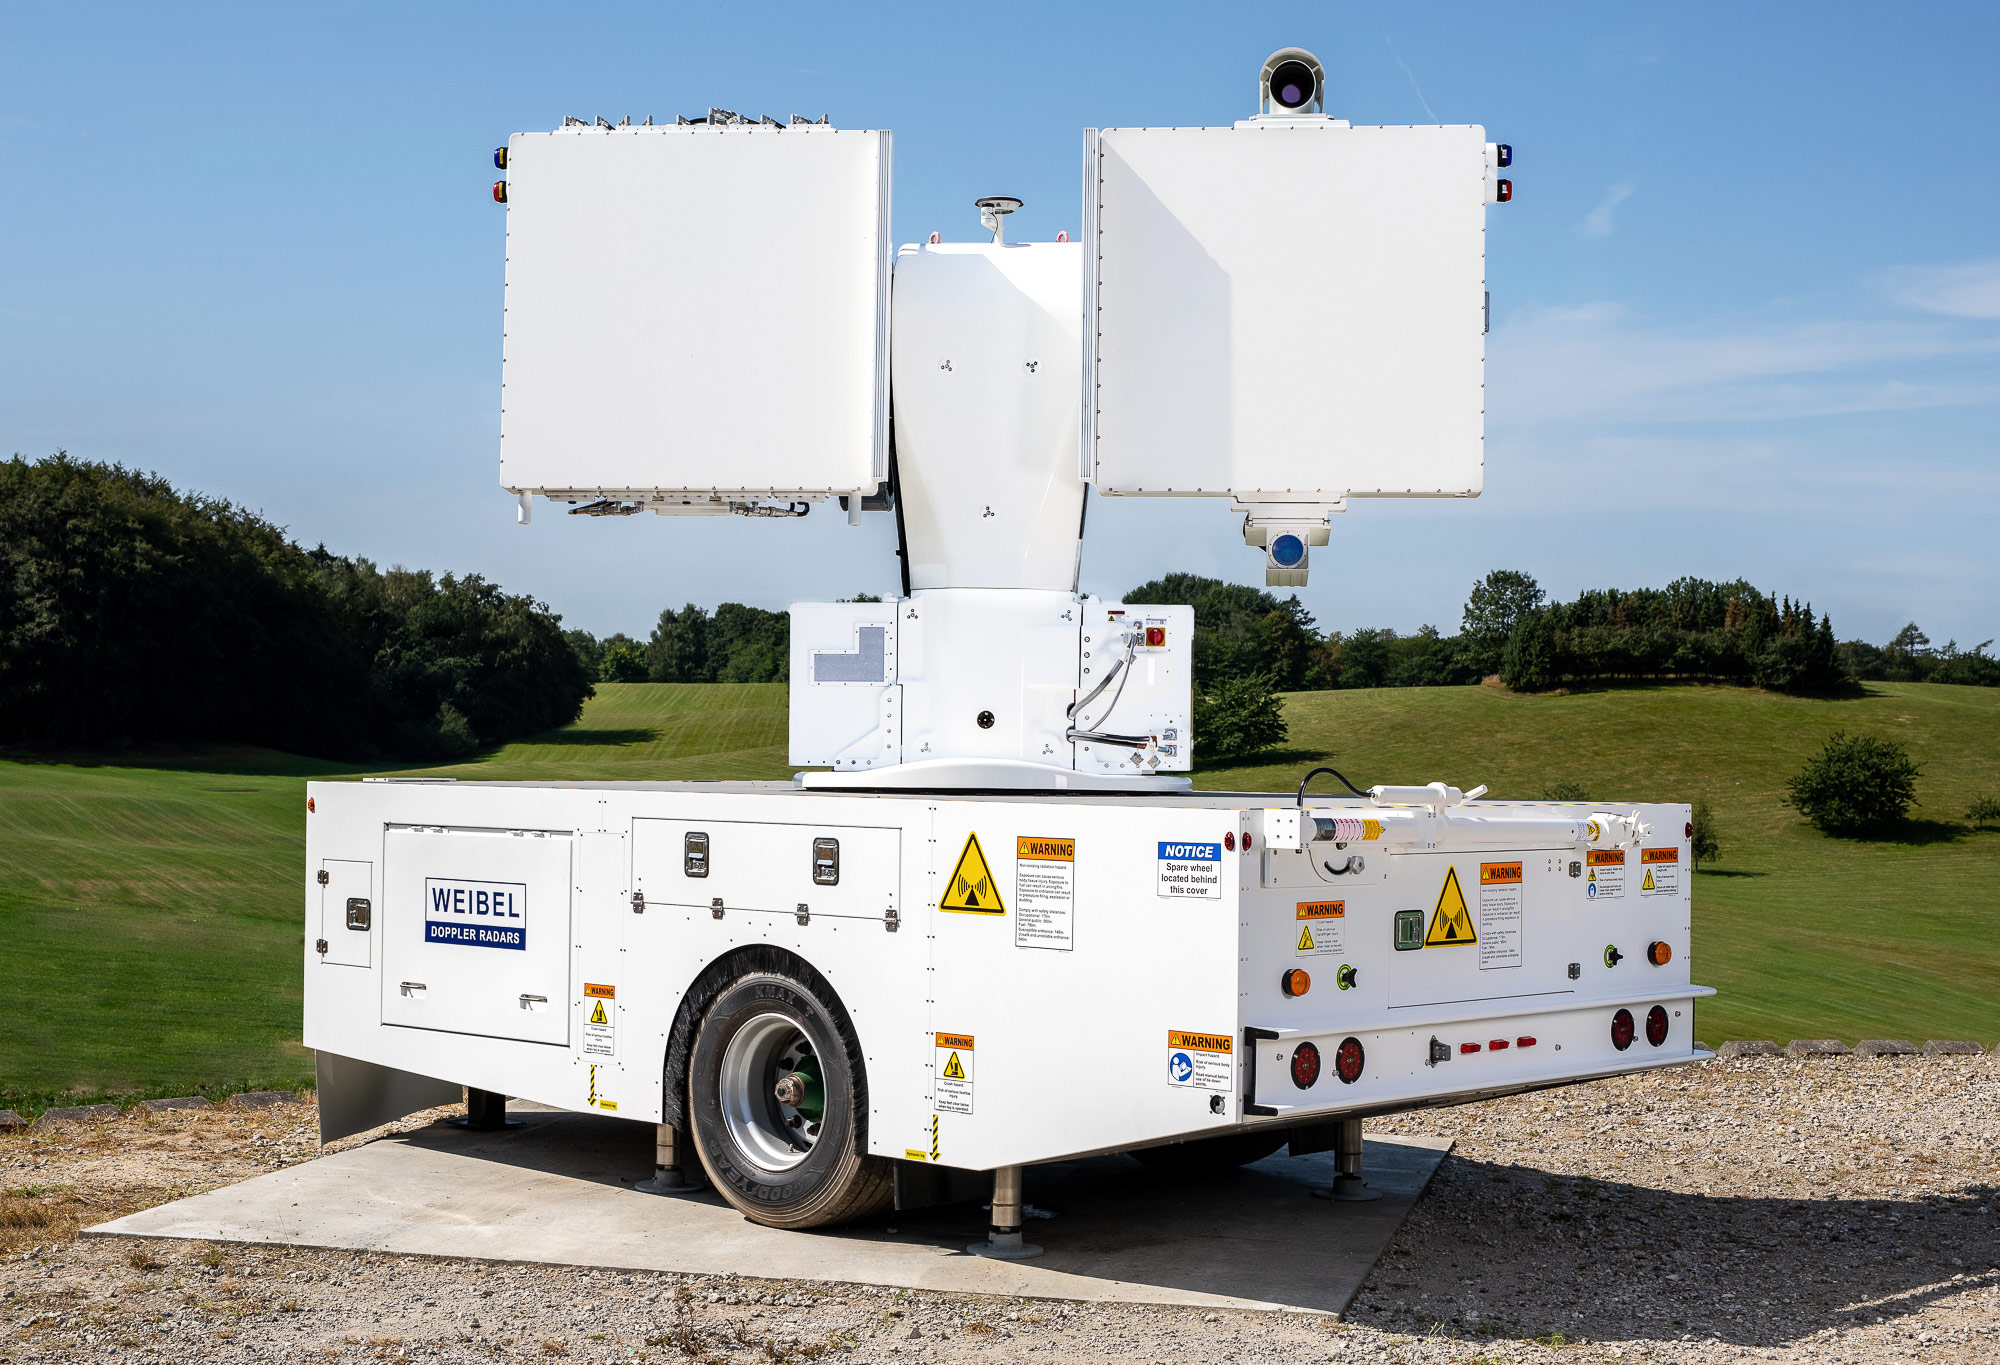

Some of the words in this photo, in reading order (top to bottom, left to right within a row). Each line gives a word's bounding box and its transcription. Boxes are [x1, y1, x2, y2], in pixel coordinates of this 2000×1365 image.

[1031, 842, 1072, 856] WARNING
[1165, 845, 1214, 858] NOTICE
[1649, 850, 1677, 860] WARNING
[1595, 852, 1624, 863] WARNING
[1166, 862, 1188, 872] Spare
[1190, 864, 1212, 872] wheel
[1490, 867, 1521, 879] WARNING
[1161, 873, 1189, 882] located
[1191, 875, 1217, 883] behind
[1170, 885, 1184, 893] this
[432, 888, 520, 918] WEIBEL
[1307, 904, 1343, 916] WARNING
[431, 926, 476, 940] DOPPLER
[480, 930, 520, 944] RADARS
[591, 987, 613, 996] WARNING
[755, 985, 796, 1005] KMAX
[944, 1036, 972, 1048] WARNING
[1182, 1034, 1230, 1050] WARNING
[708, 1139, 808, 1200] GOODYEAR
